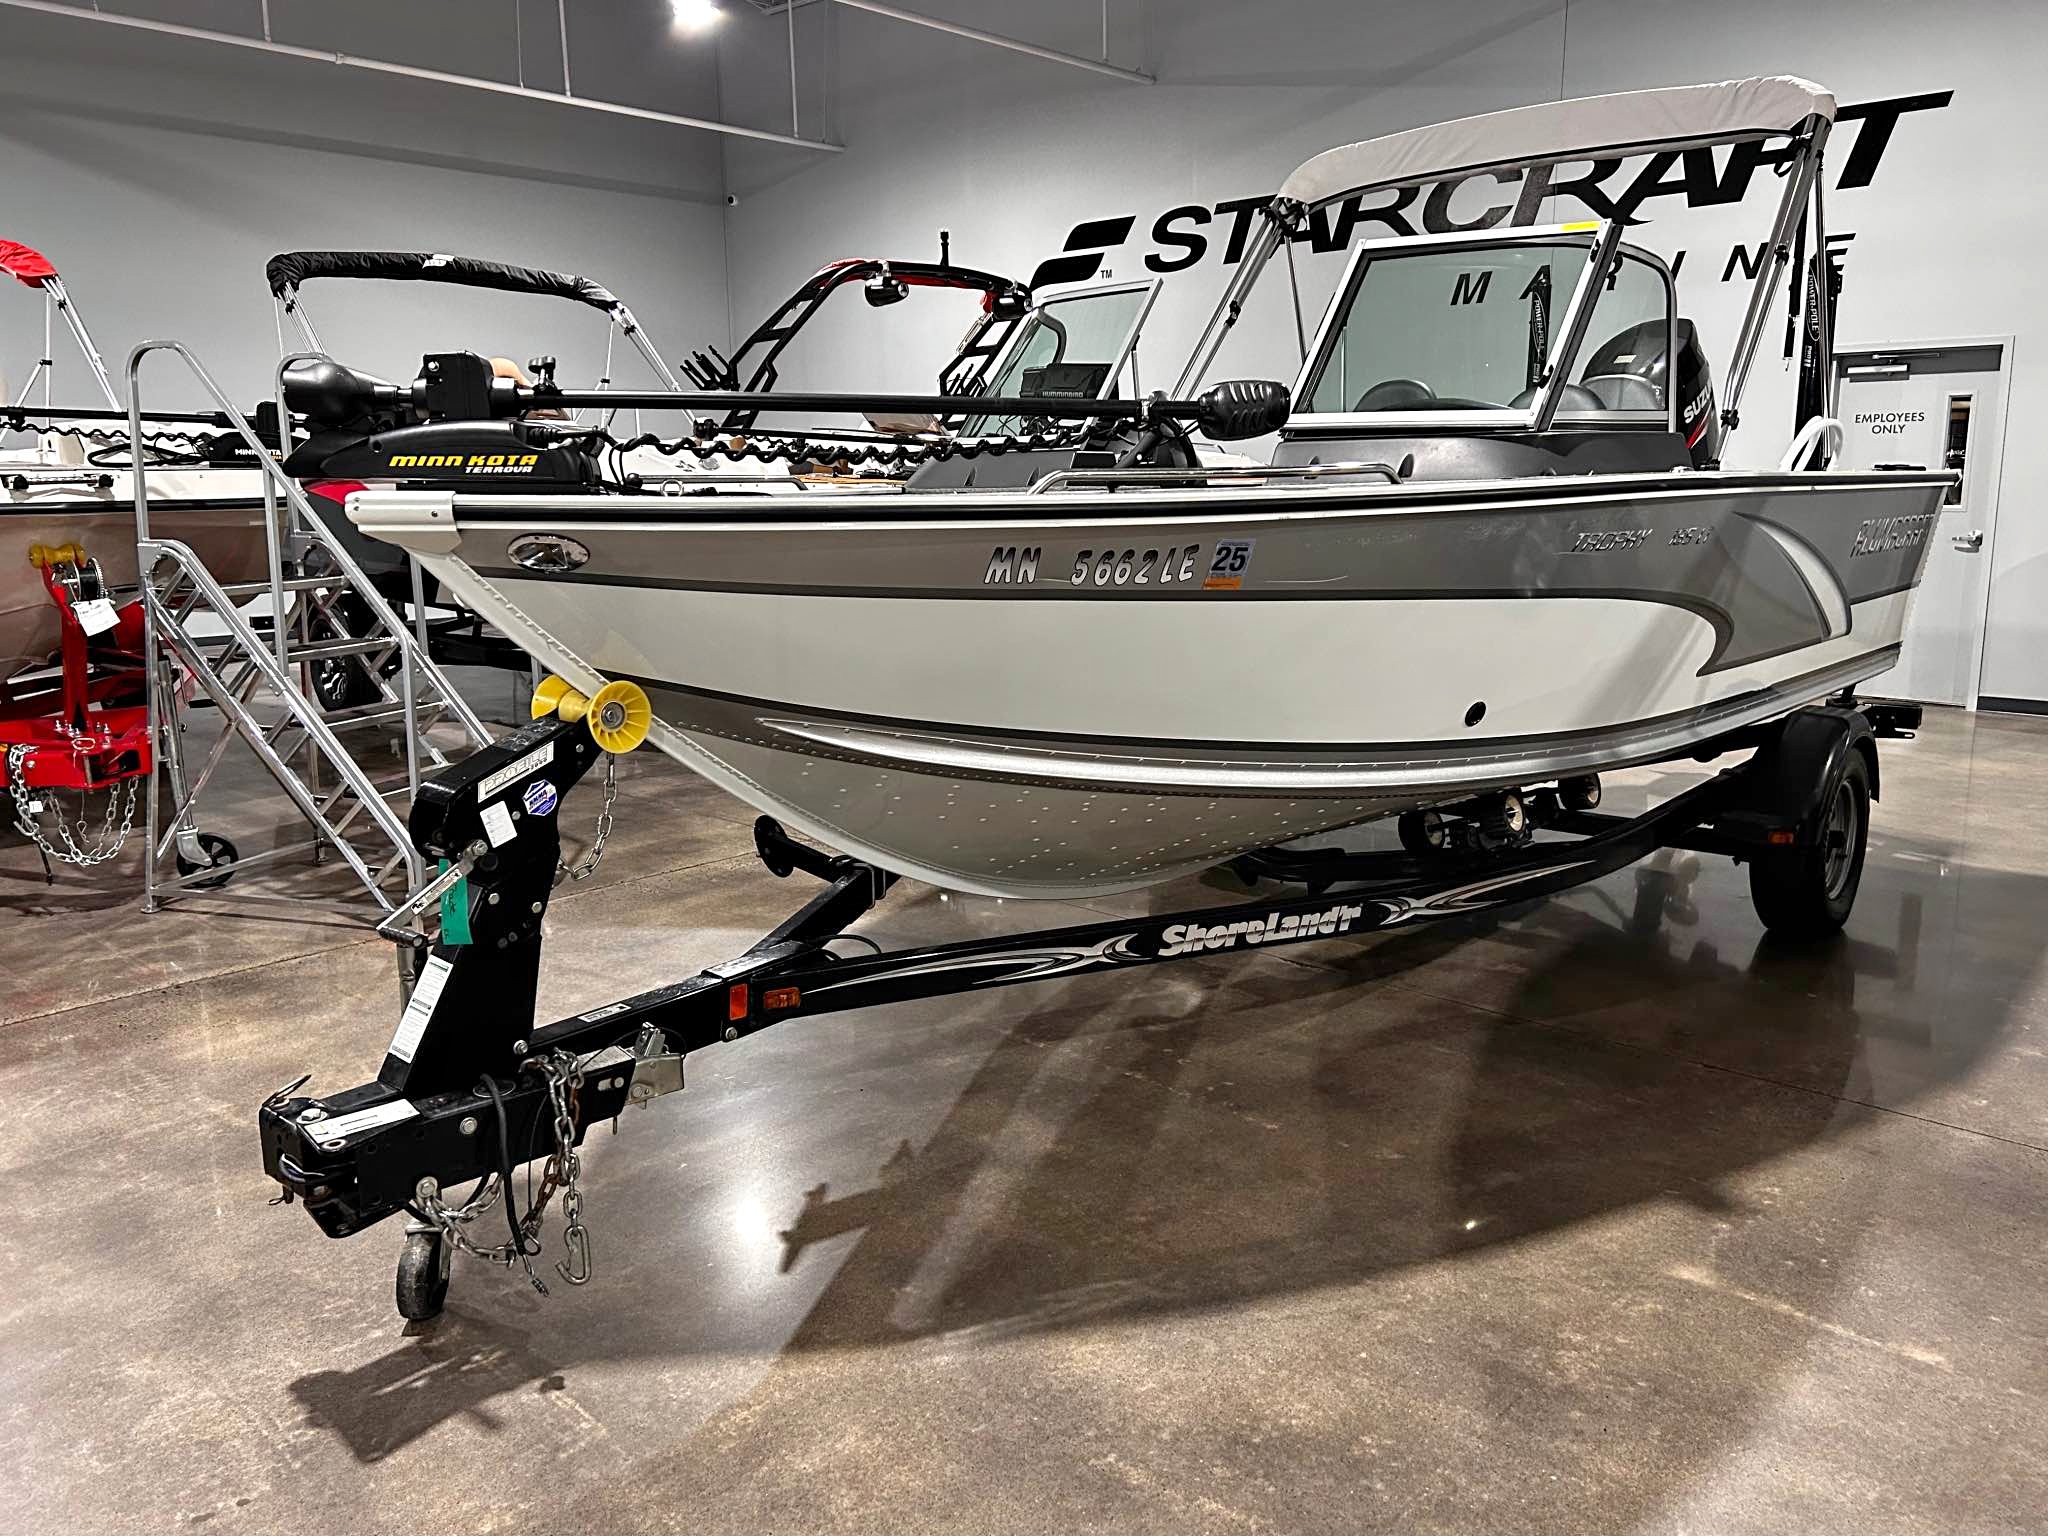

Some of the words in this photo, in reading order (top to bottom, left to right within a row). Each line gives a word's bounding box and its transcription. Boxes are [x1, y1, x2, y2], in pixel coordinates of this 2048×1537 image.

[1855, 412, 1925, 424] EMPLOYEES
[1871, 424, 1906, 434] ONLY
[467, 455, 538, 466] KOTA
[465, 466, 533, 474] TERROVA
[1210, 546, 1249, 572] 25
[984, 547, 1042, 585] MN
[1157, 903, 1363, 958] ShoreLand'r
